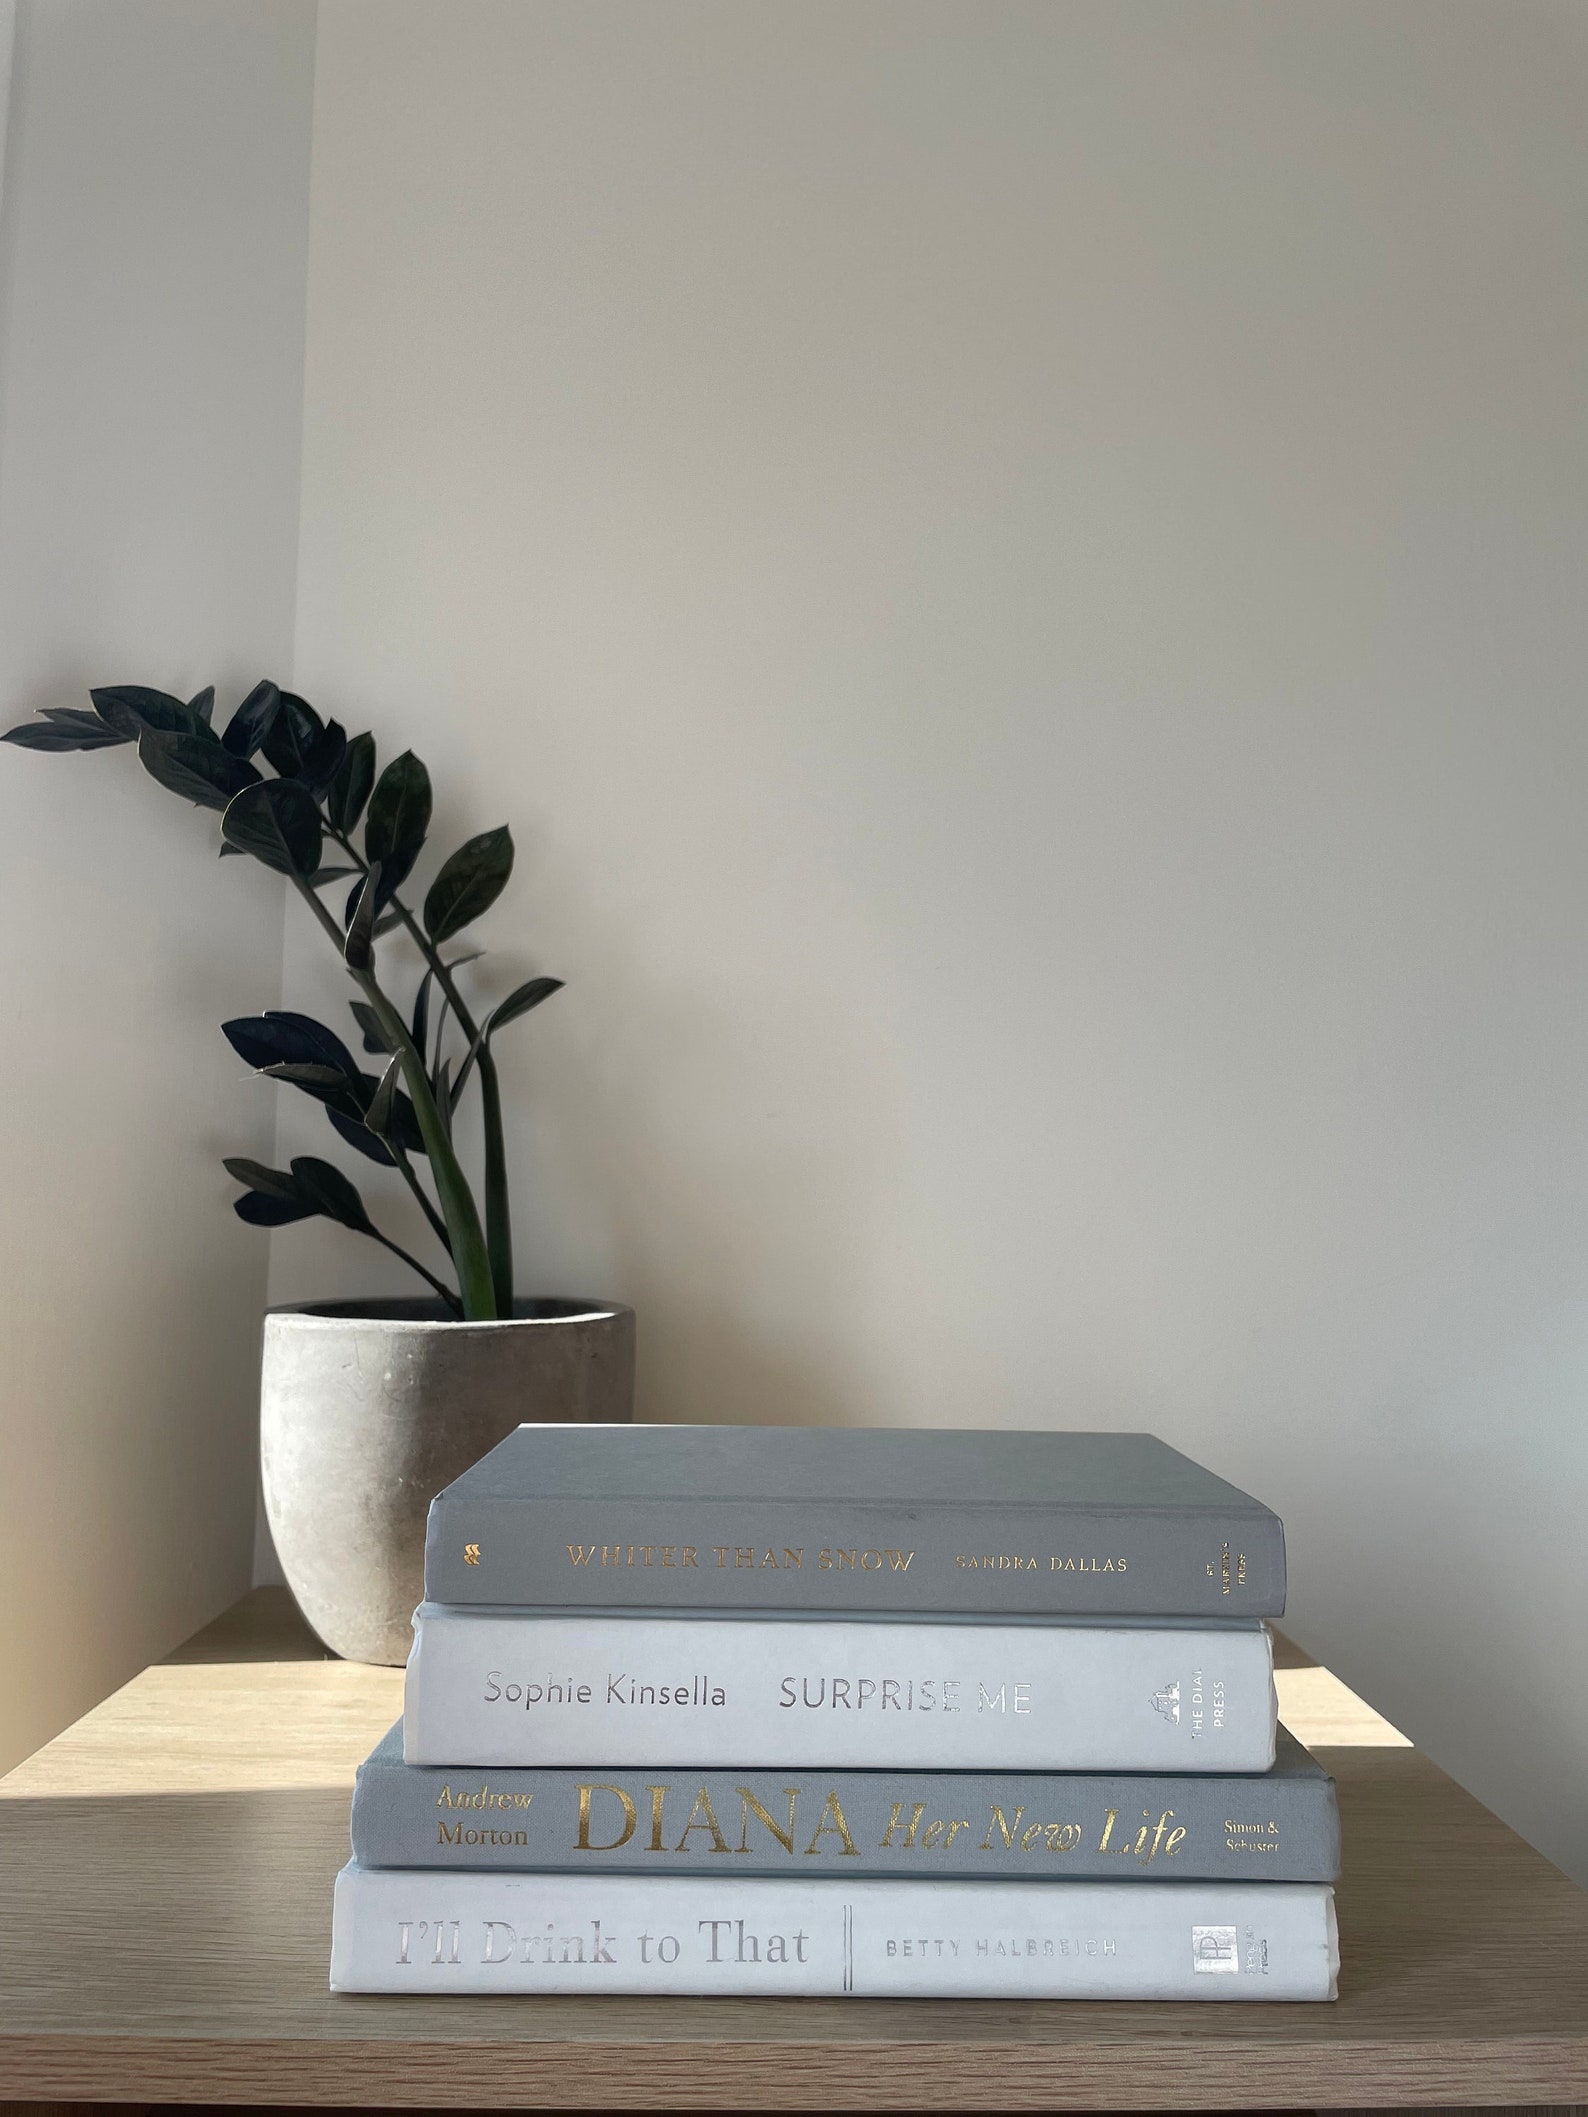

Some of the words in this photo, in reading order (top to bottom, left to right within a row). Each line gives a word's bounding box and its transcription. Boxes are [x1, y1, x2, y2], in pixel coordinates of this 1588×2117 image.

[566, 1544, 699, 1568] WHITER
[713, 1546, 804, 1569] THAN
[818, 1548, 916, 1572] SNOW
[955, 1554, 1040, 1571] SANDRA
[1049, 1556, 1129, 1573] DALLAS
[484, 1671, 592, 1710] Sophie
[606, 1673, 727, 1706] Kinsella
[779, 1676, 961, 1712] SURPRISE
[977, 1681, 1032, 1714] ME
[1191, 1668, 1203, 1704] DIAL
[1213, 1681, 1225, 1727] PRESS
[1191, 1710, 1203, 1739] THE
[436, 1783, 534, 1811] Andrew
[436, 1821, 529, 1846] Morton
[573, 1784, 861, 1856] DIANA
[879, 1802, 970, 1849] Her
[979, 1804, 1083, 1852] New
[1097, 1808, 1187, 1866] Life
[1224, 1819, 1264, 1834] Simon
[1267, 1821, 1279, 1834] &
[396, 1920, 462, 1964] I'll
[481, 1920, 617, 1964] Drink
[637, 1929, 681, 1964] to
[698, 1919, 810, 1964] That
[886, 1939, 960, 1957] BETTY
[975, 1939, 1117, 1957] HALBREICH
